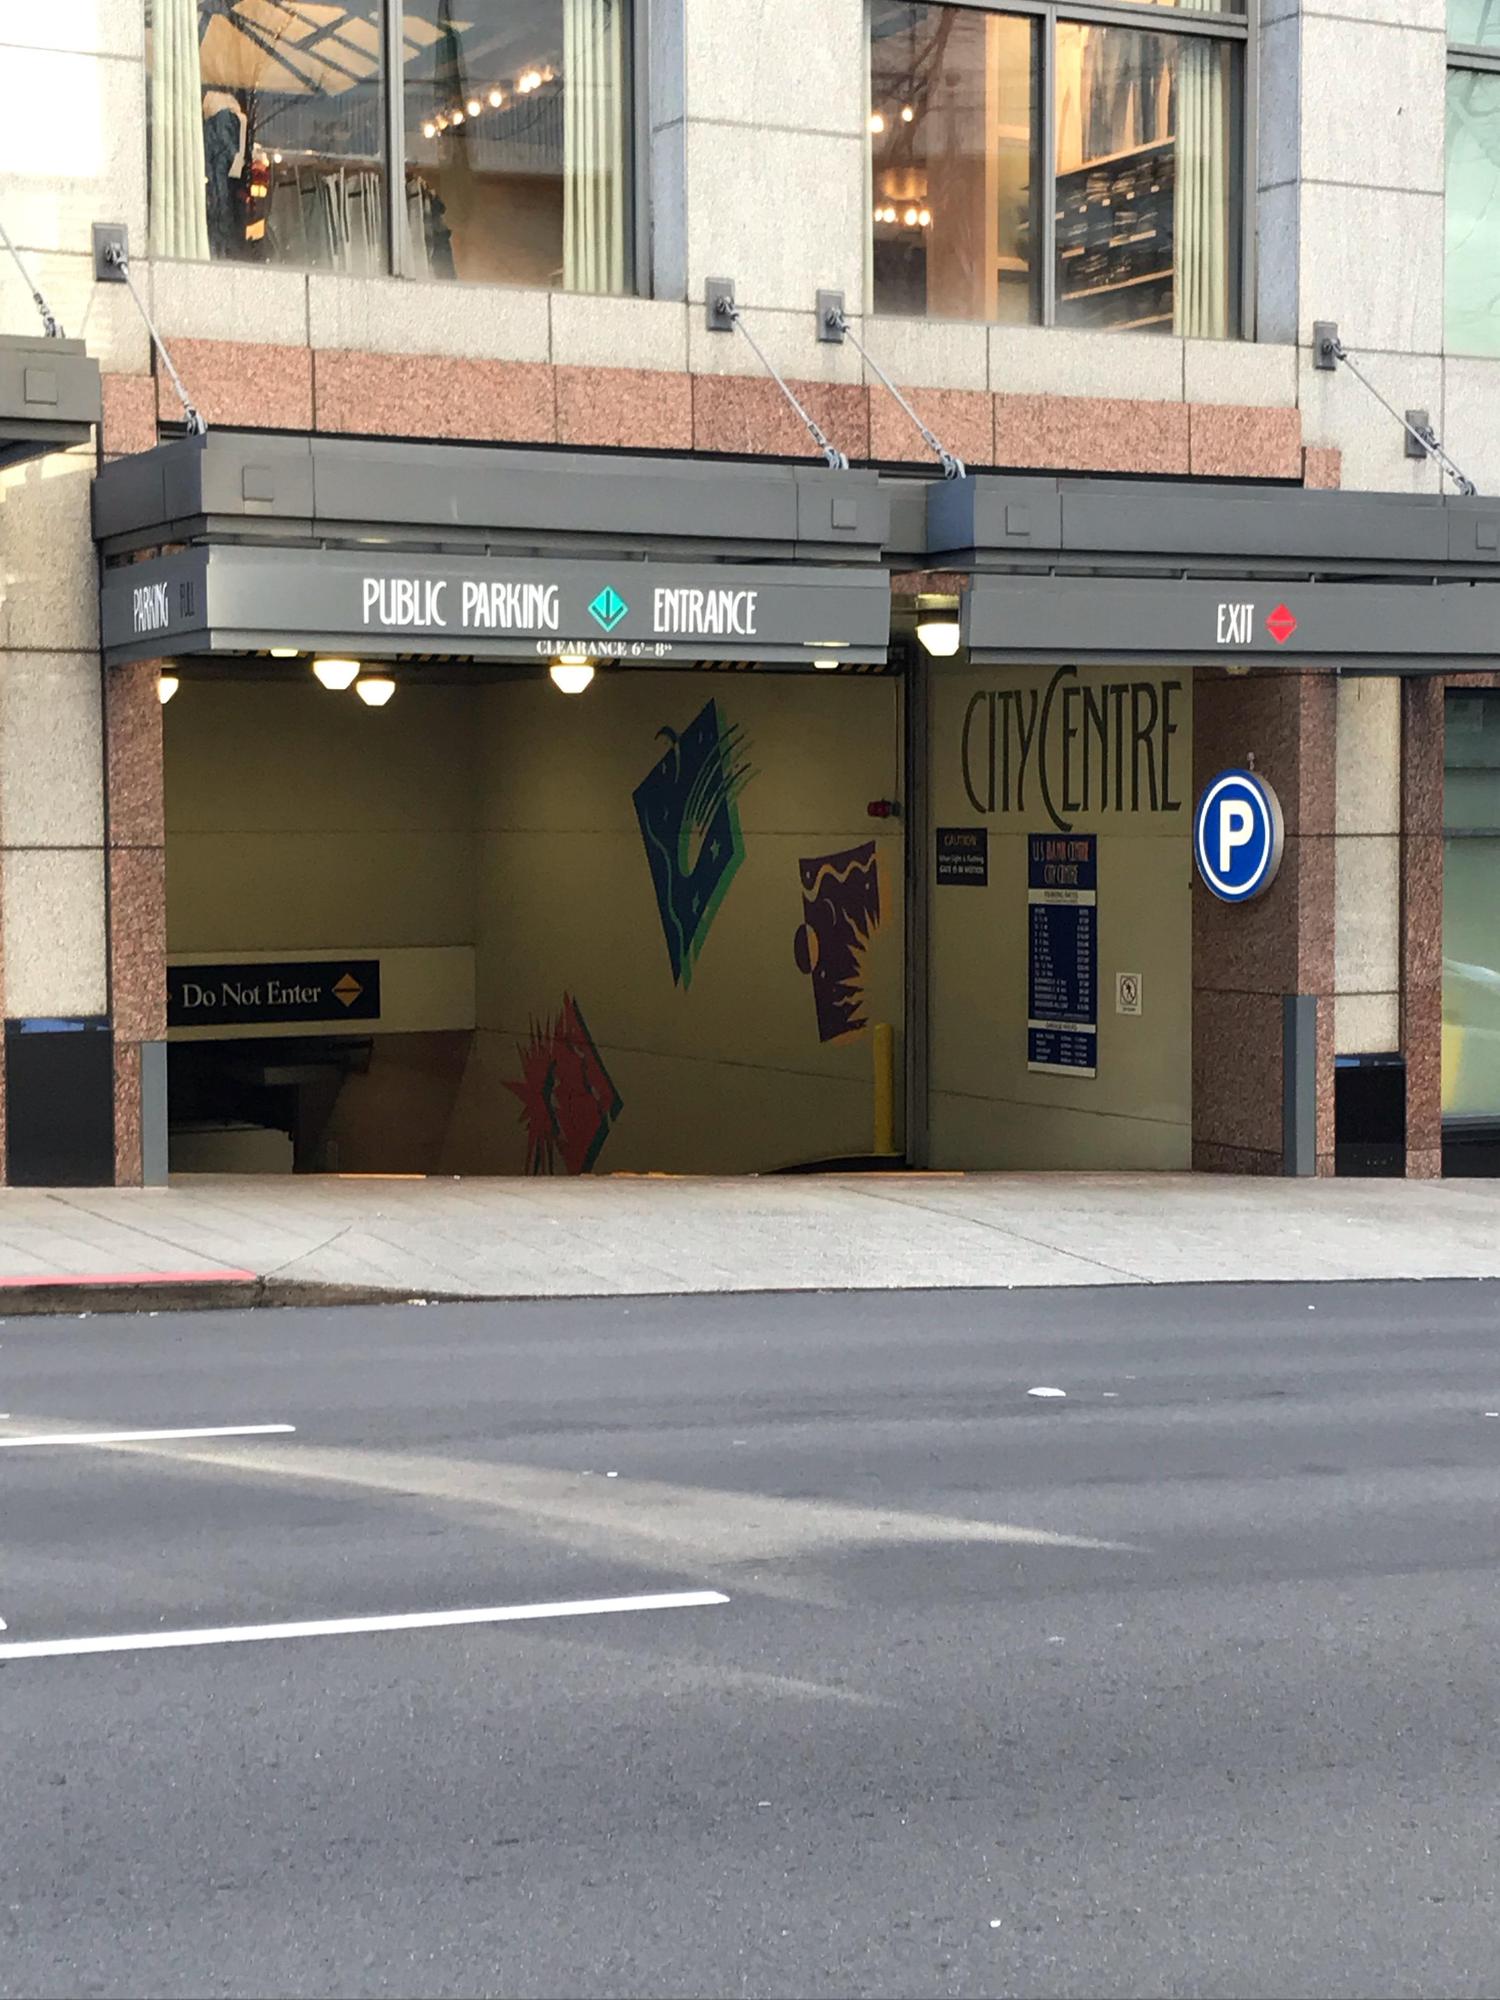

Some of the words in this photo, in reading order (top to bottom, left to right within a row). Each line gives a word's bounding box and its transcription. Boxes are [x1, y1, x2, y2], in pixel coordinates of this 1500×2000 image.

[133, 581, 169, 633] PARKING
[363, 577, 447, 626] PUBLIC
[462, 581, 559, 630] PARKING
[653, 588, 758, 635] ENTRANCE
[1216, 603, 1254, 644] EXIT
[536, 639, 627, 656] CLEARANCE
[943, 833, 977, 847] CAUTION
[1219, 799, 1254, 873] P
[182, 983, 216, 1008] Do
[222, 981, 261, 1006] Not
[267, 980, 322, 1005] Enter
